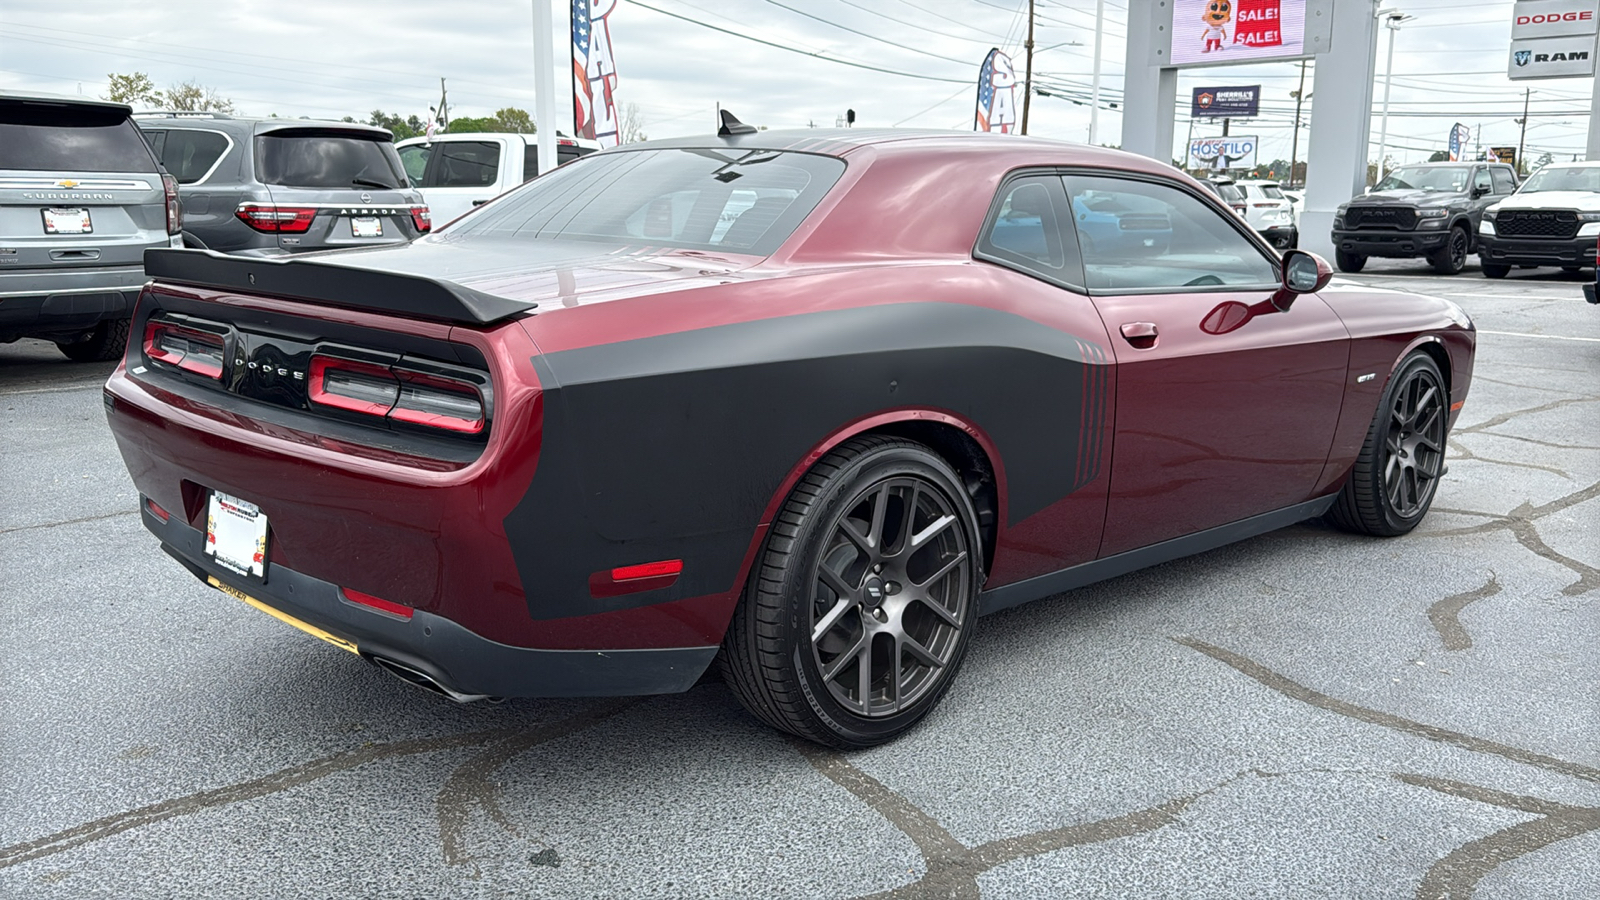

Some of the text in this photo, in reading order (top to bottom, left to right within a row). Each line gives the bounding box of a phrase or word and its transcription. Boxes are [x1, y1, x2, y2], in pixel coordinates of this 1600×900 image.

[1238, 8, 1278, 22] SALE!
[1517, 11, 1593, 25] DODGE
[1236, 30, 1278, 44] SALE!
[1534, 51, 1589, 62] RAM
[1216, 91, 1253, 99] SHERRILL'S
[1191, 142, 1253, 155] HOSTILO
[235, 358, 304, 380] DODGE
[218, 581, 247, 601] SHAKER
